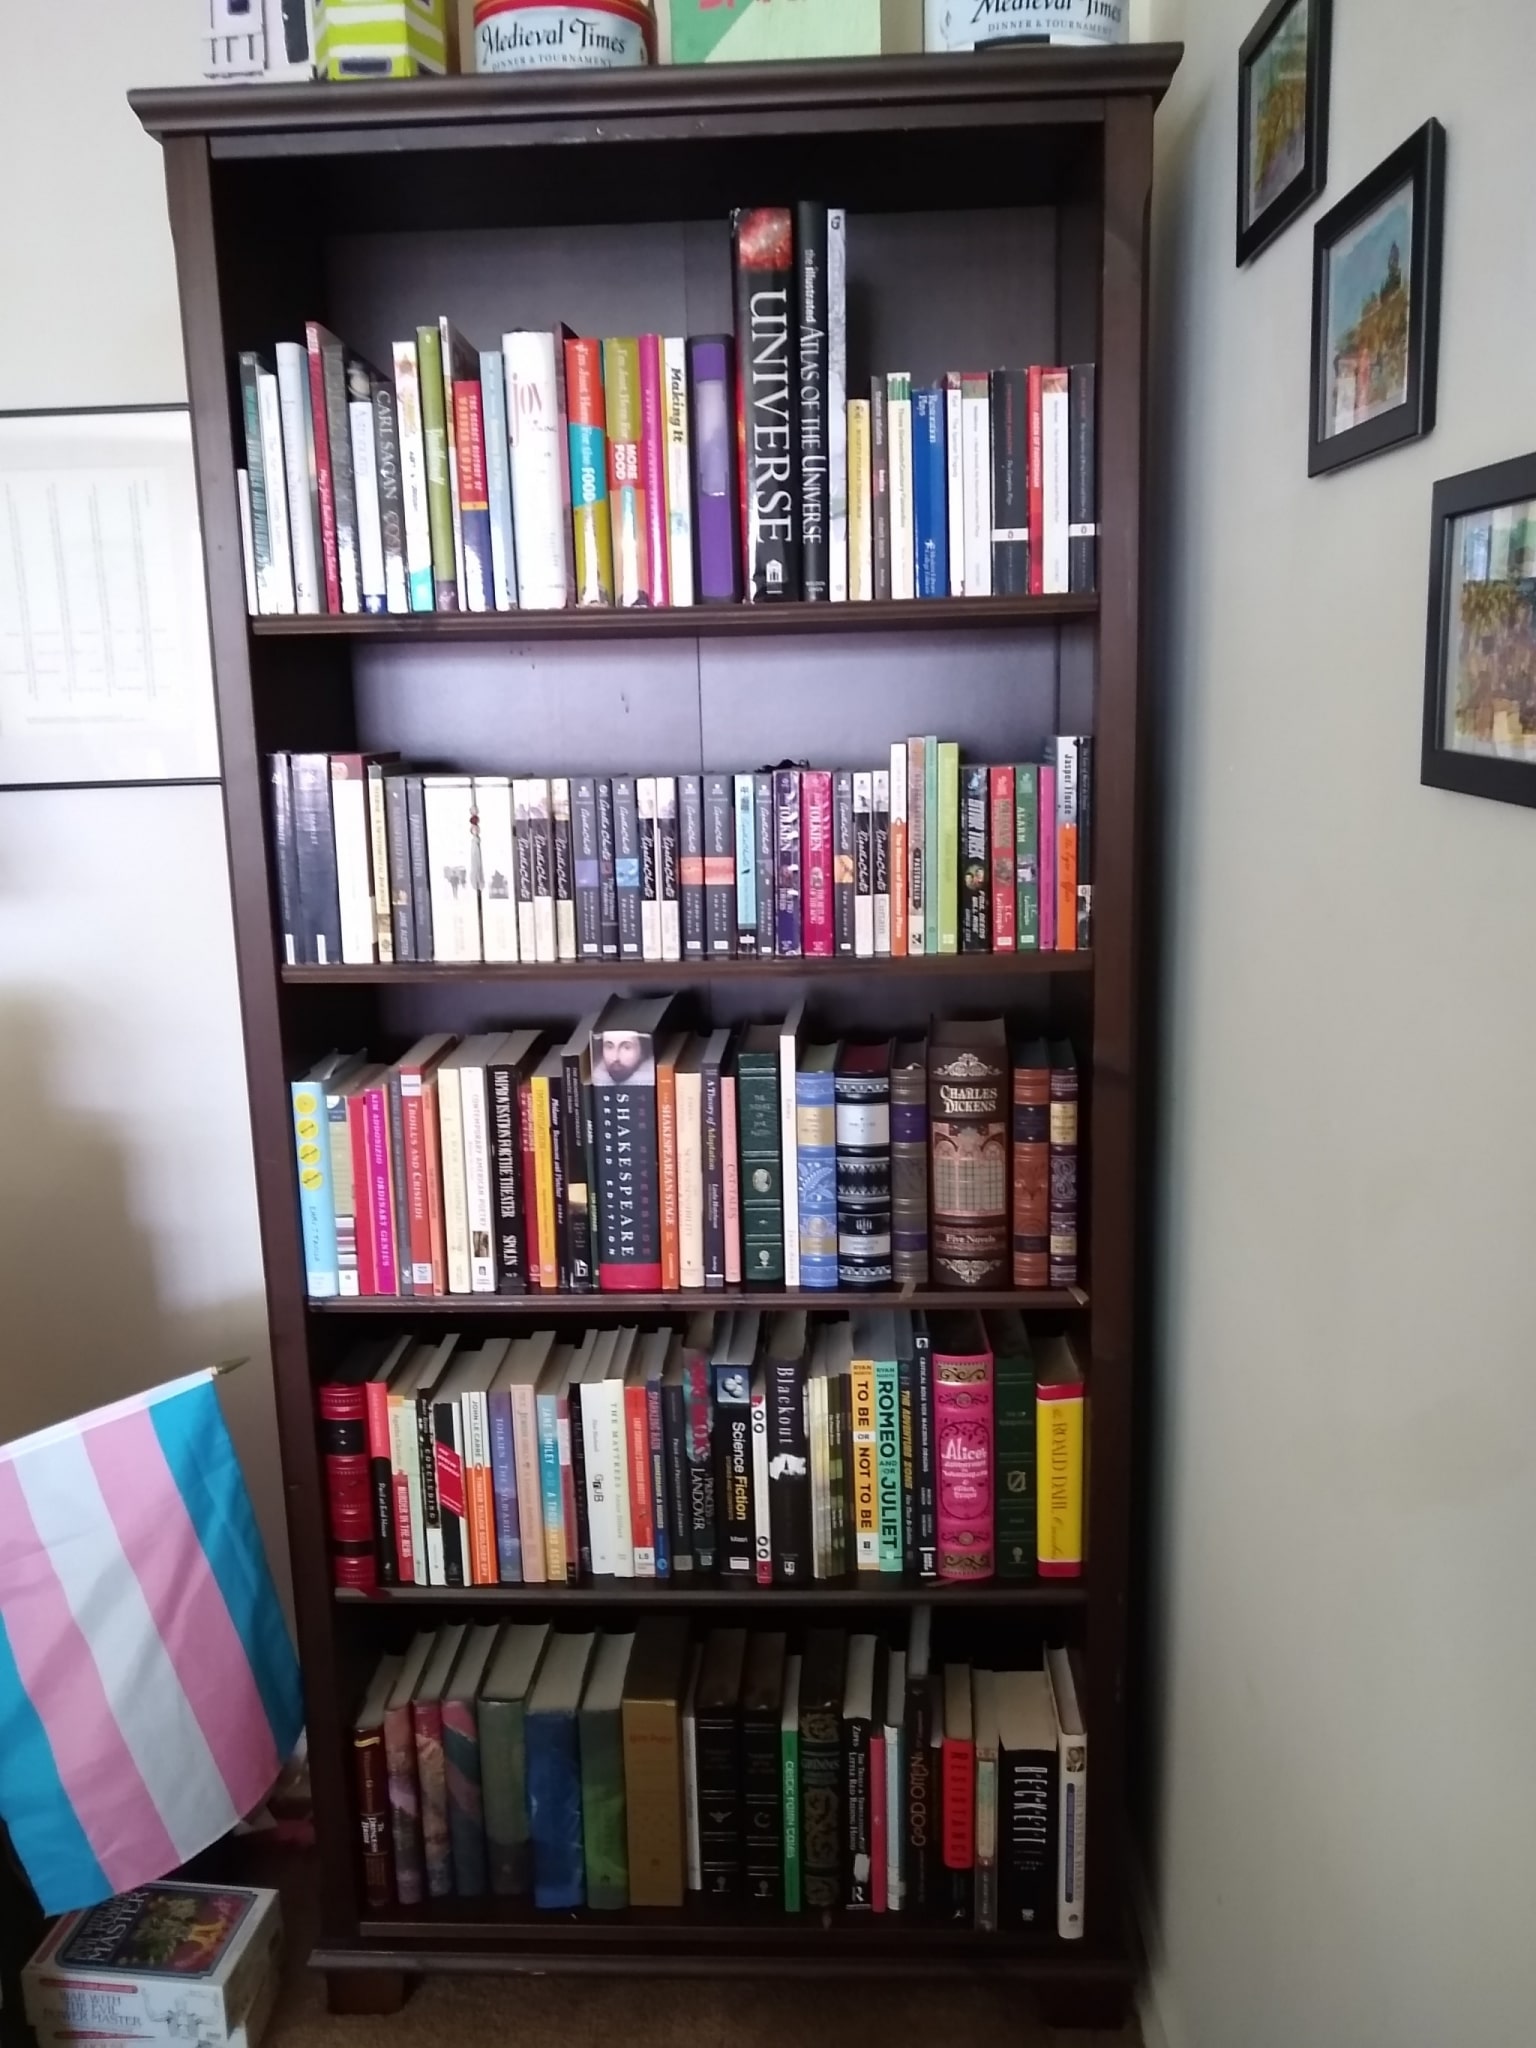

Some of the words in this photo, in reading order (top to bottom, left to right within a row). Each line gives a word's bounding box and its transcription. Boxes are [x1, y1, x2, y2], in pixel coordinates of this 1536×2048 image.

[482, 18, 563, 65] Medieval
[569, 18, 626, 54] Times
[988, 20, 1032, 32] DINNER
[1036, 19, 1042, 27] &
[1046, 19, 1113, 34] TOURNAMENT
[804, 249, 816, 265] the
[804, 266, 819, 323] illustrated
[576, 345, 588, 366] I'm
[617, 349, 627, 366] I'm
[799, 325, 825, 381] ATLAS
[578, 368, 589, 394] Just
[618, 368, 628, 391] Just
[376, 390, 392, 435] CARL
[468, 395, 477, 411] THE
[580, 396, 591, 423] Here
[618, 395, 629, 420] Here
[668, 367, 685, 426] Making
[800, 385, 821, 410] OF
[875, 391, 883, 417] theatre
[917, 395, 927, 416] Plays
[459, 397, 470, 442] WONDER
[470, 413, 479, 442] SECRET
[620, 422, 630, 439] For
[749, 289, 792, 544] UNIVERSE
[876, 419, 884, 445] studies
[928, 395, 938, 443] Restoration
[1032, 411, 1040, 432] ARDEN
[581, 427, 592, 445] For
[672, 430, 685, 443] It
[801, 416, 821, 450] THE
[1033, 434, 1040, 445] OF
[378, 441, 398, 499] SAGAN
[460, 447, 472, 490] WOMAN
[471, 445, 481, 478] HISTORY
[582, 447, 594, 465] the
[614, 444, 627, 481] FOOD
[626, 444, 638, 480] MORE
[474, 481, 482, 491] OF
[581, 467, 596, 502] FOOD
[801, 455, 826, 544] UNIVERSE
[1064, 754, 1073, 784] Jasper
[779, 805, 792, 851] TOLKIEN
[809, 805, 822, 851] TOLKIEN
[1017, 806, 1025, 843] ALARM
[410, 814, 422, 877] FRANKENSTEIN
[968, 830, 984, 860] TREK
[896, 873, 903, 881] of
[913, 858, 921, 900] PASTORALIA
[399, 911, 407, 927] JANE
[878, 898, 887, 934] Curtain
[371, 1094, 379, 1110] KIM
[494, 1072, 511, 1138] IMPROVISATION
[707, 1087, 715, 1115] Theory
[940, 1086, 998, 1100] CHARLES
[944, 1098, 996, 1113] DICKENS
[408, 1101, 418, 1145] TROILUS
[472, 1094, 484, 1154] CONTEMPORARY
[551, 1098, 559, 1126] Philaster
[637, 1094, 646, 1130] THE
[708, 1117, 716, 1125] of
[372, 1114, 383, 1164] ADDONIZIO
[603, 1095, 613, 1165] SECOND
[411, 1148, 420, 1168] AND
[499, 1139, 511, 1157] FOR
[662, 1104, 673, 1192] SHAKESPEAREAN
[708, 1127, 716, 1170] Adaptation
[476, 1158, 485, 1195] AMERICAN
[499, 1157, 513, 1176] THE
[616, 1093, 634, 1257] SHAKESPEARE
[376, 1176, 386, 1226] ORDINARY
[411, 1172, 423, 1220] CRISEYDE
[500, 1177, 515, 1218] THEATER
[554, 1173, 563, 1198] Fletcher
[639, 1146, 651, 1256] RIVERSIDE
[606, 1180, 616, 1256] EDITION
[664, 1194, 674, 1226] STAGE
[380, 1230, 390, 1267] GENIUS
[502, 1235, 517, 1265] SPOLIN
[946, 1234, 963, 1243] Five
[966, 1234, 996, 1244] Novels
[776, 1367, 795, 1444] Blackout
[857, 1381, 869, 1401] TO
[901, 1390, 911, 1406] THE
[542, 1407, 552, 1428] JANE
[610, 1403, 618, 1424] THE
[648, 1391, 660, 1430] SPARKLING
[858, 1407, 870, 1426] BE
[878, 1381, 896, 1458] ROMEO
[473, 1423, 480, 1431] LE
[495, 1418, 505, 1458] TOLKIEN
[651, 1432, 661, 1450] RAIN
[903, 1408, 912, 1458] ADVENTURE
[543, 1433, 554, 1464] SMILEY
[612, 1431, 621, 1488] MAYTREES
[731, 1421, 747, 1473] Science
[859, 1447, 871, 1478] NOT
[941, 1438, 988, 1461] Alice's
[1051, 1424, 1067, 1471] ROALD
[425, 1448, 436, 1519] CONCLUDING
[499, 1463, 508, 1483] THE
[378, 1483, 388, 1496] Peril
[398, 1486, 408, 1513] MURDER
[690, 1468, 705, 1530] LANDOVER
[703, 1477, 713, 1518] PRINCESS
[734, 1476, 748, 1520] Fiction
[860, 1485, 871, 1503] TO
[1051, 1476, 1067, 1510] DAHL
[379, 1506, 387, 1517] End
[399, 1515, 409, 1524] IN
[501, 1487, 512, 1557] SILMARILLION
[547, 1501, 557, 1545] THOUSAND
[861, 1509, 872, 1529] BE
[881, 1476, 897, 1550] JULIET
[400, 1525, 410, 1539] THE
[551, 1549, 561, 1575] ACRES
[950, 1752, 968, 1863] RESISTANCE
[1013, 1766, 1048, 1844] BECKETT
[88, 1893, 149, 1961] MASTER
